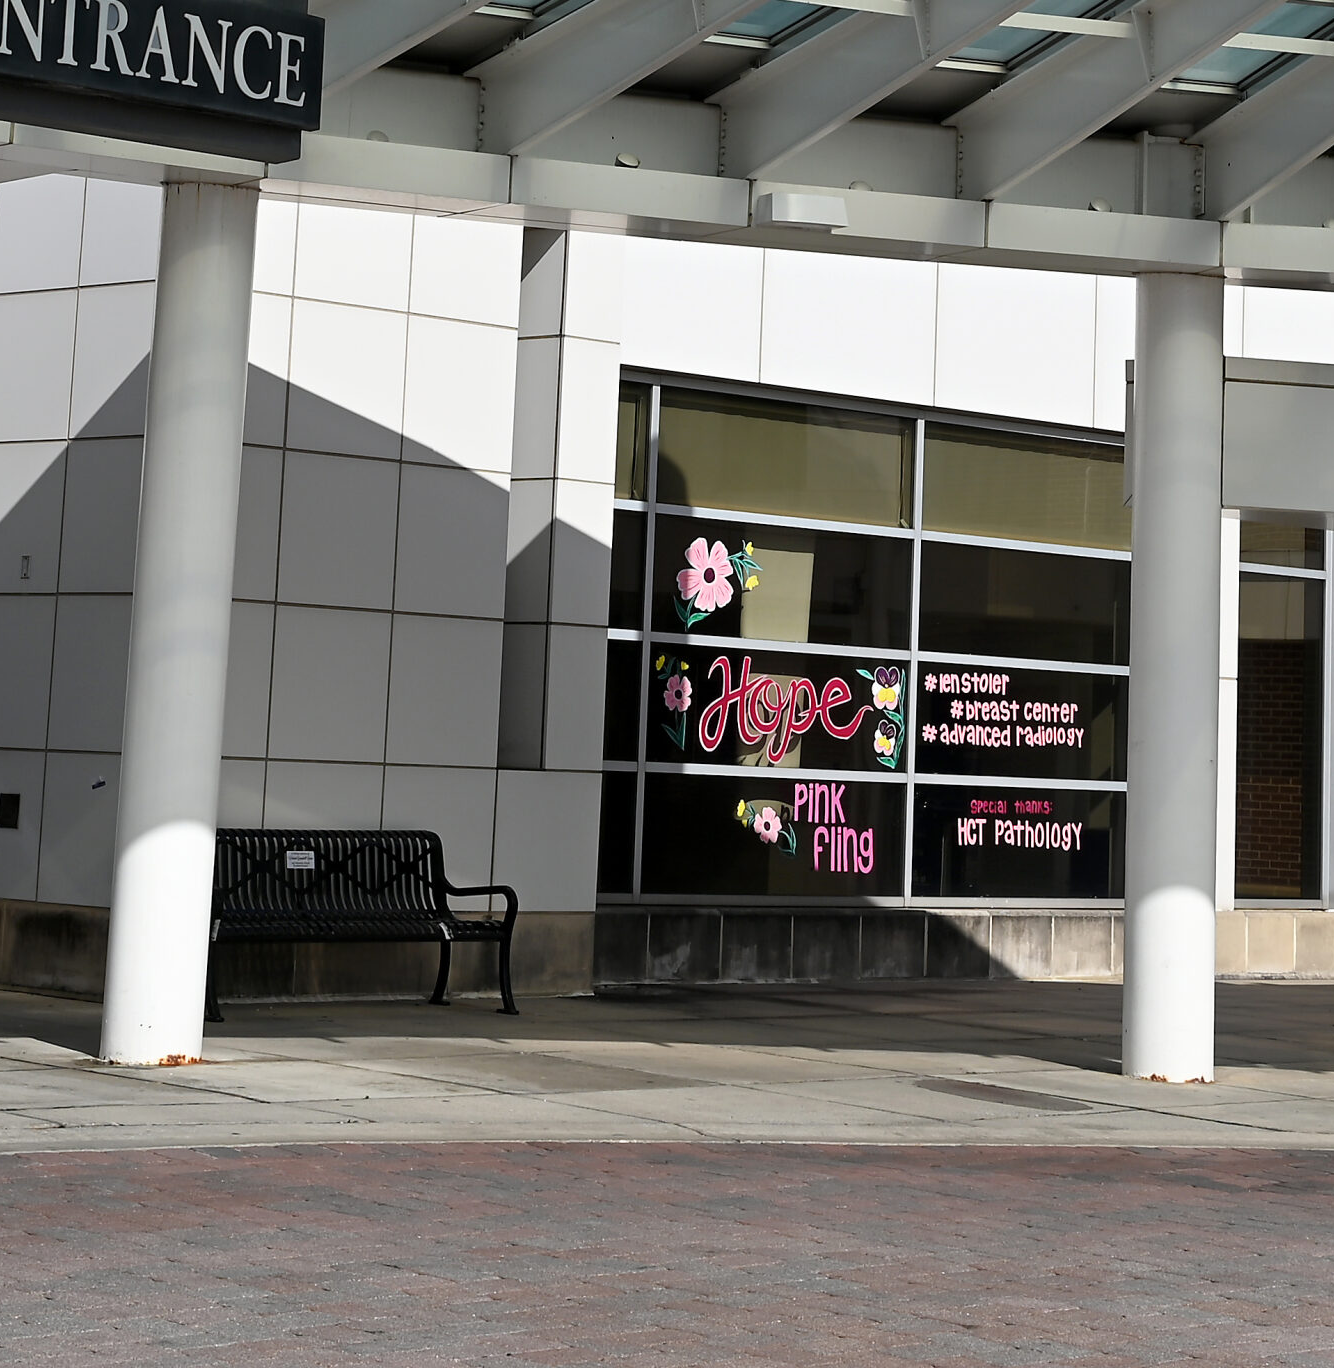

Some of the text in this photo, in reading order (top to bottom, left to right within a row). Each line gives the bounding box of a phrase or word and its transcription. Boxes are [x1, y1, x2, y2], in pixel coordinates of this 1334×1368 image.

[699, 656, 874, 763] Hope
[950, 699, 1078, 723] #breast center
[1016, 725, 1085, 748] radiology
[957, 817, 987, 846] HCT
